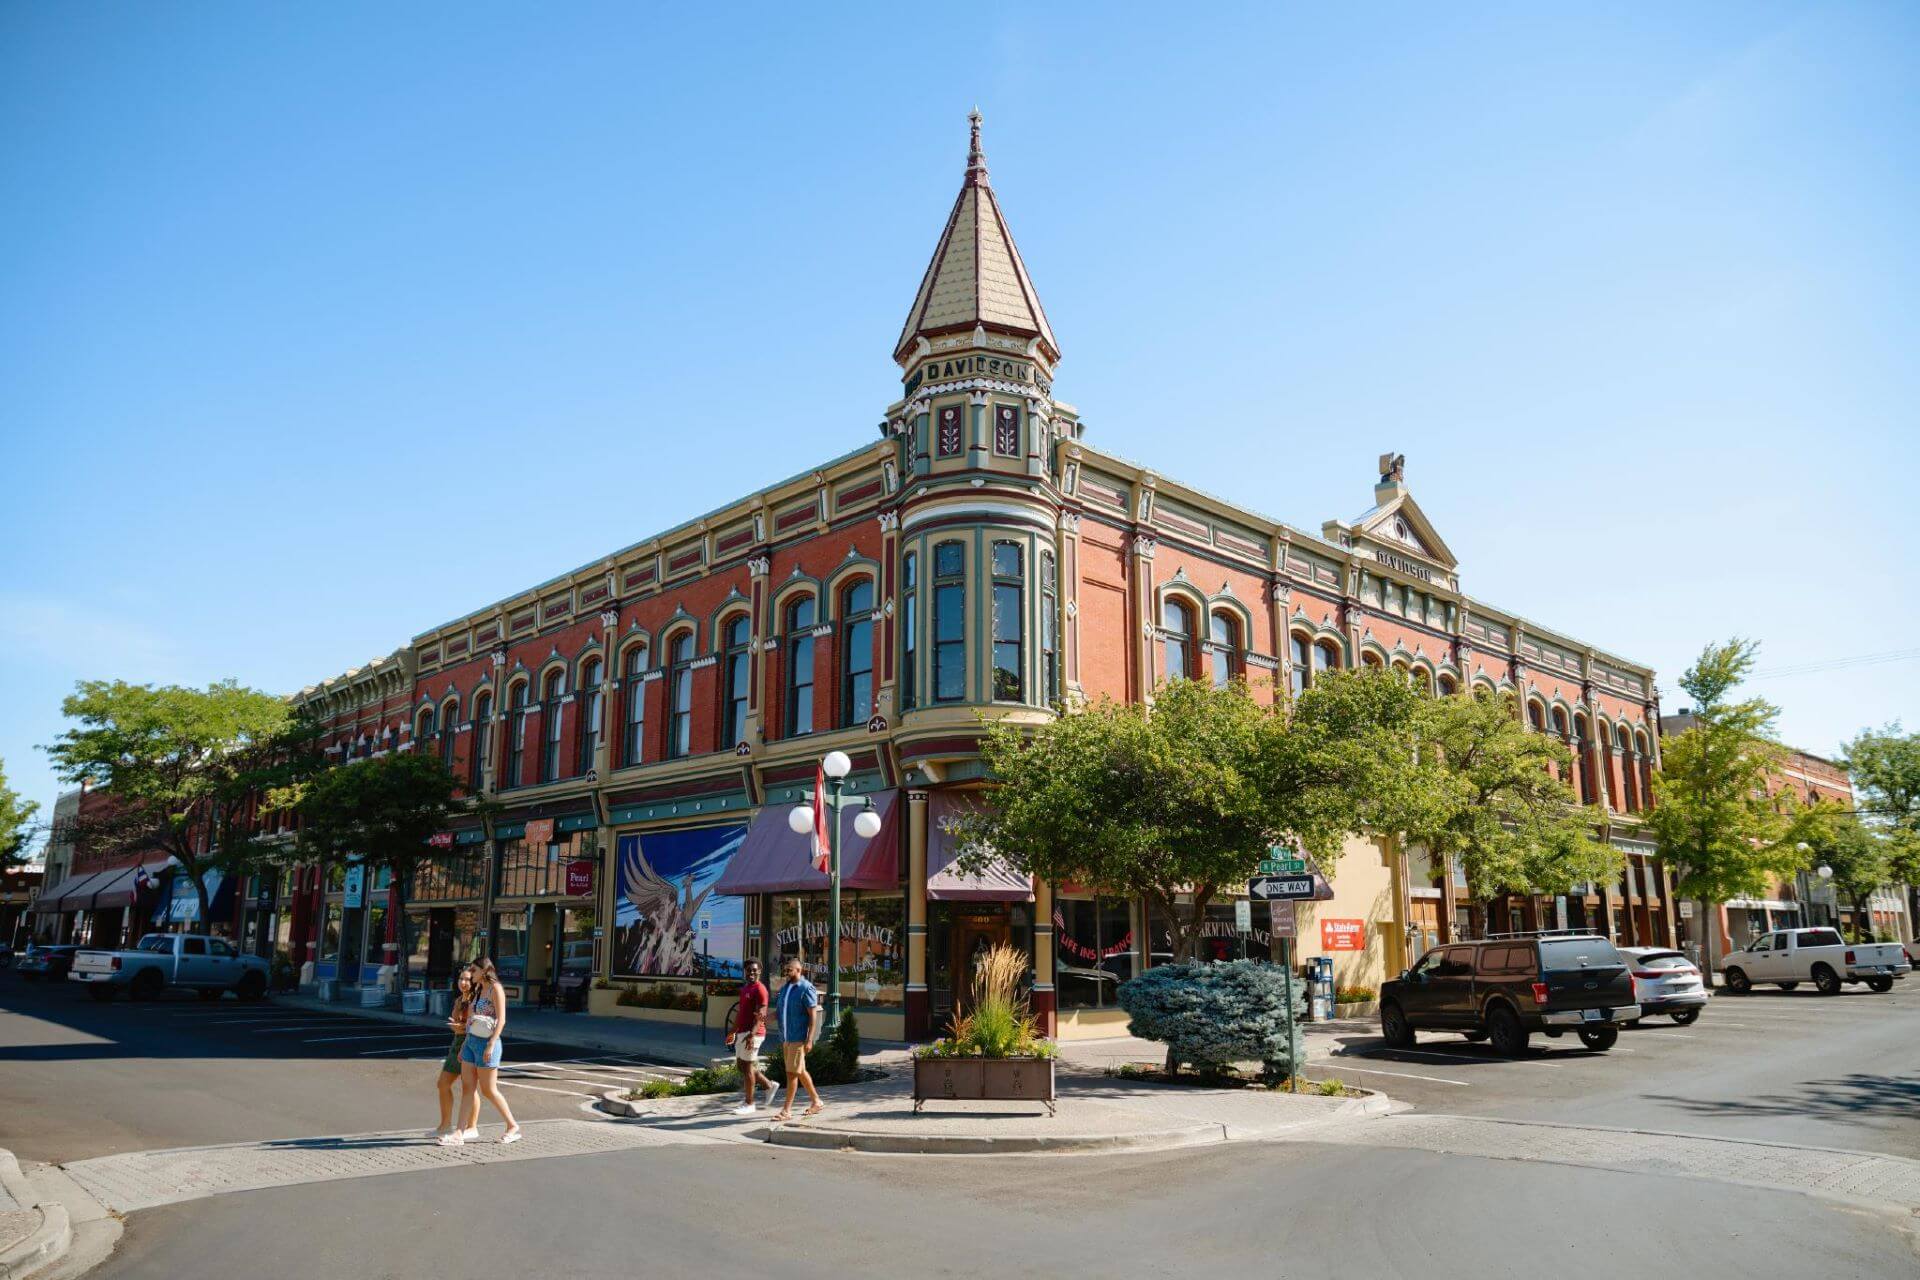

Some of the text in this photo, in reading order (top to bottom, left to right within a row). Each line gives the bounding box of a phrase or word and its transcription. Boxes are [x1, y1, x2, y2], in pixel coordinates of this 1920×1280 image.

[927, 357, 1029, 380] DAVIDSON
[1376, 550, 1432, 582] DAVIDSON
[1271, 862, 1292, 871] Pearl
[1266, 882, 1307, 893] ONE WAY
[838, 921, 894, 946] NSURANCE
[1199, 921, 1219, 938] ARM
[1060, 932, 1079, 954] LIFE
